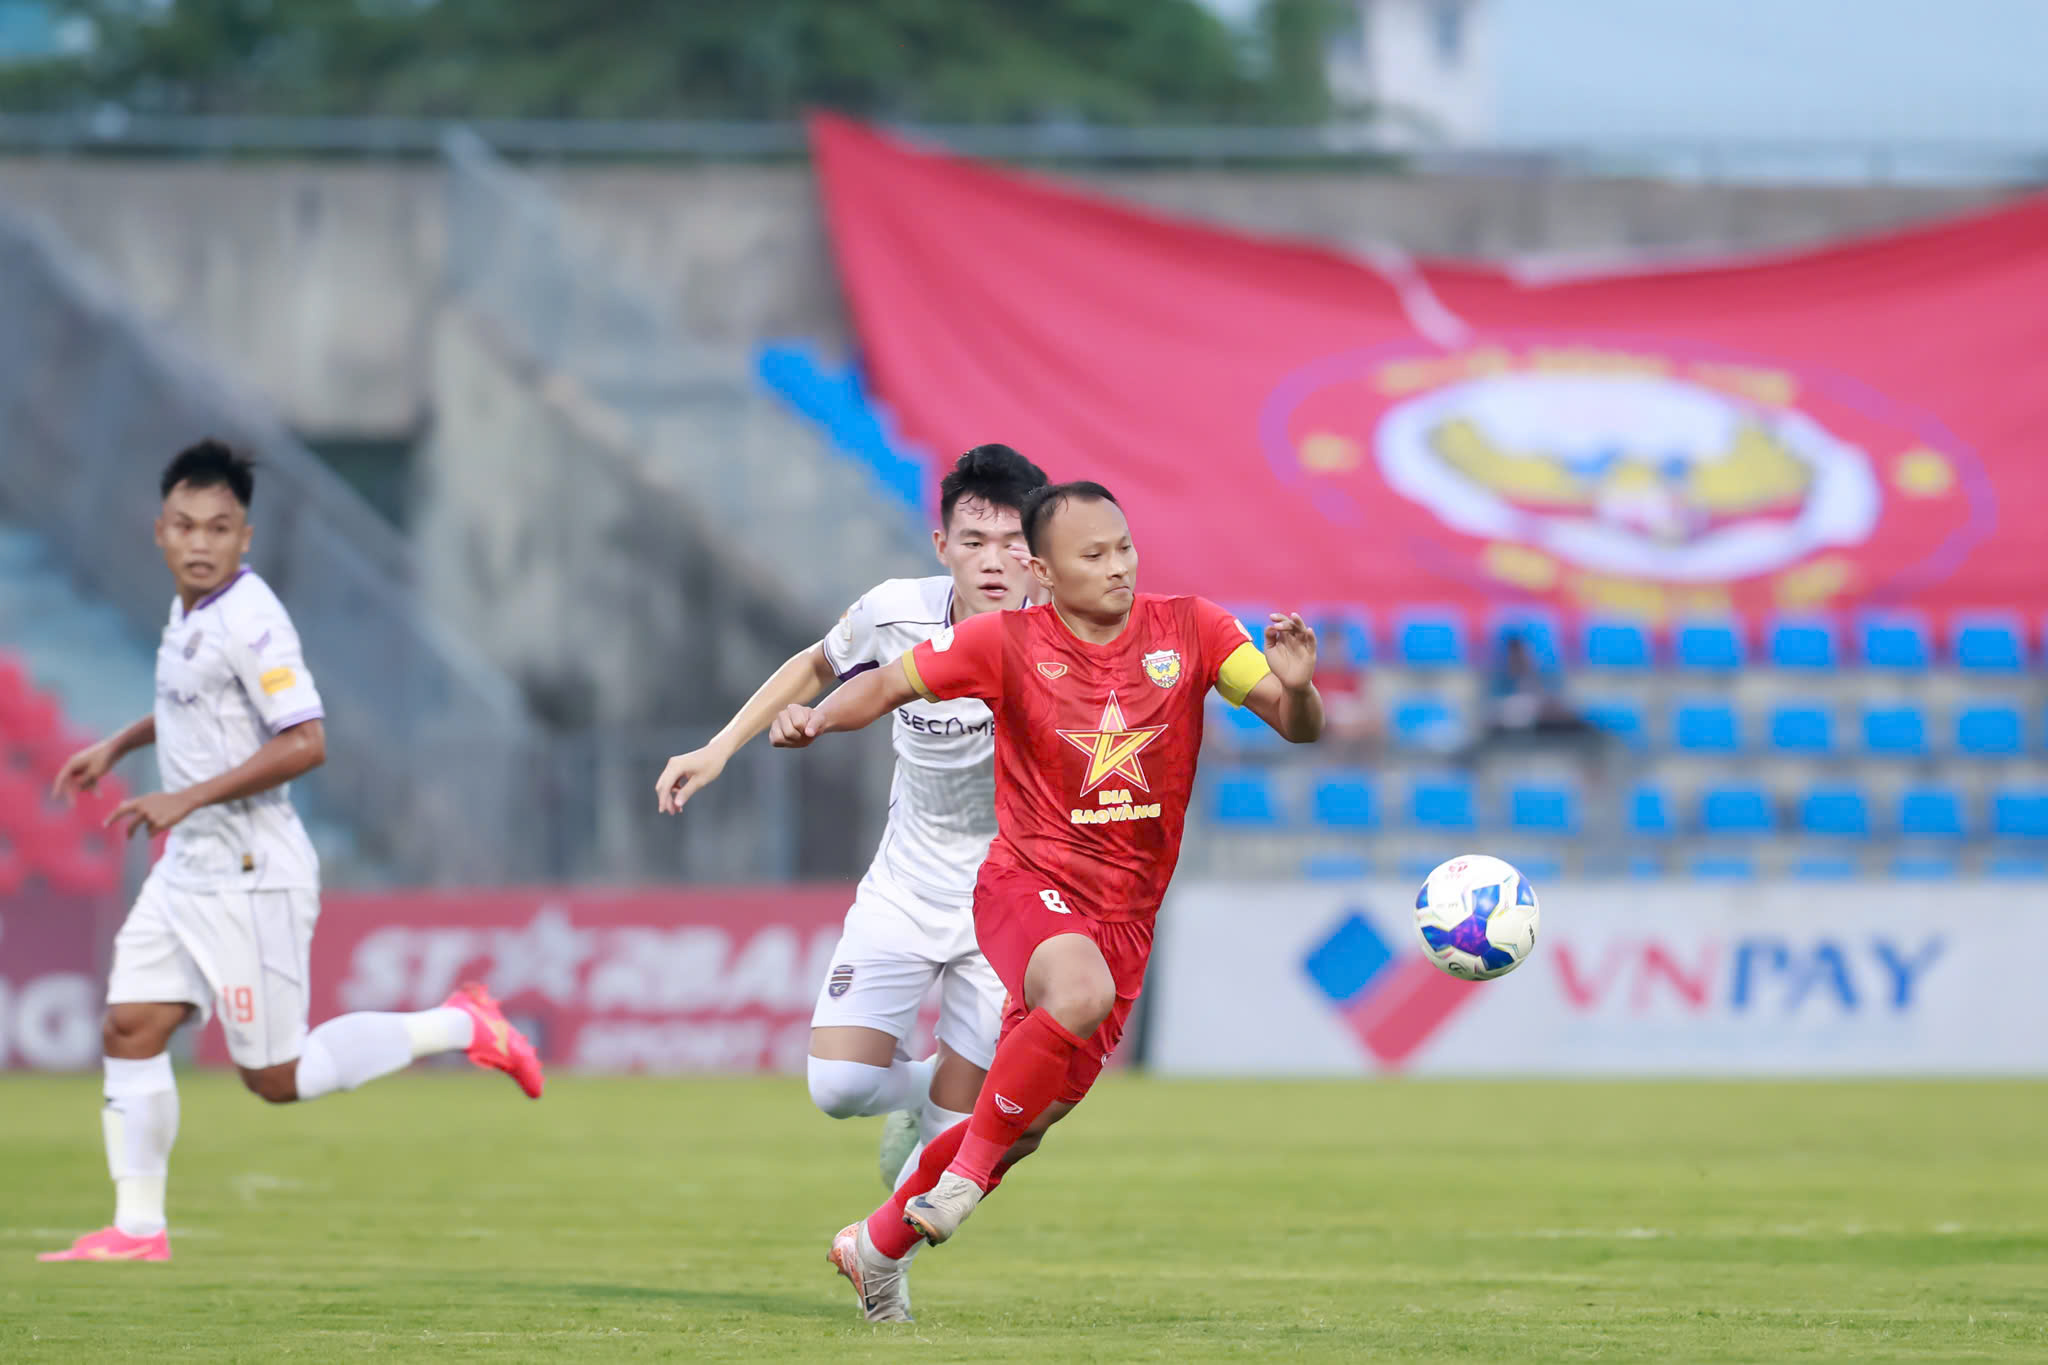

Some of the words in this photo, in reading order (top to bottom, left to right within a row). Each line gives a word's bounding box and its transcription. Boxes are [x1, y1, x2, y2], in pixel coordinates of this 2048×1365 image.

[1098, 789, 1133, 805] BIA
[1038, 889, 1072, 914] 8
[1550, 937, 1946, 1013] VNPAY
[221, 985, 255, 1023] 19
